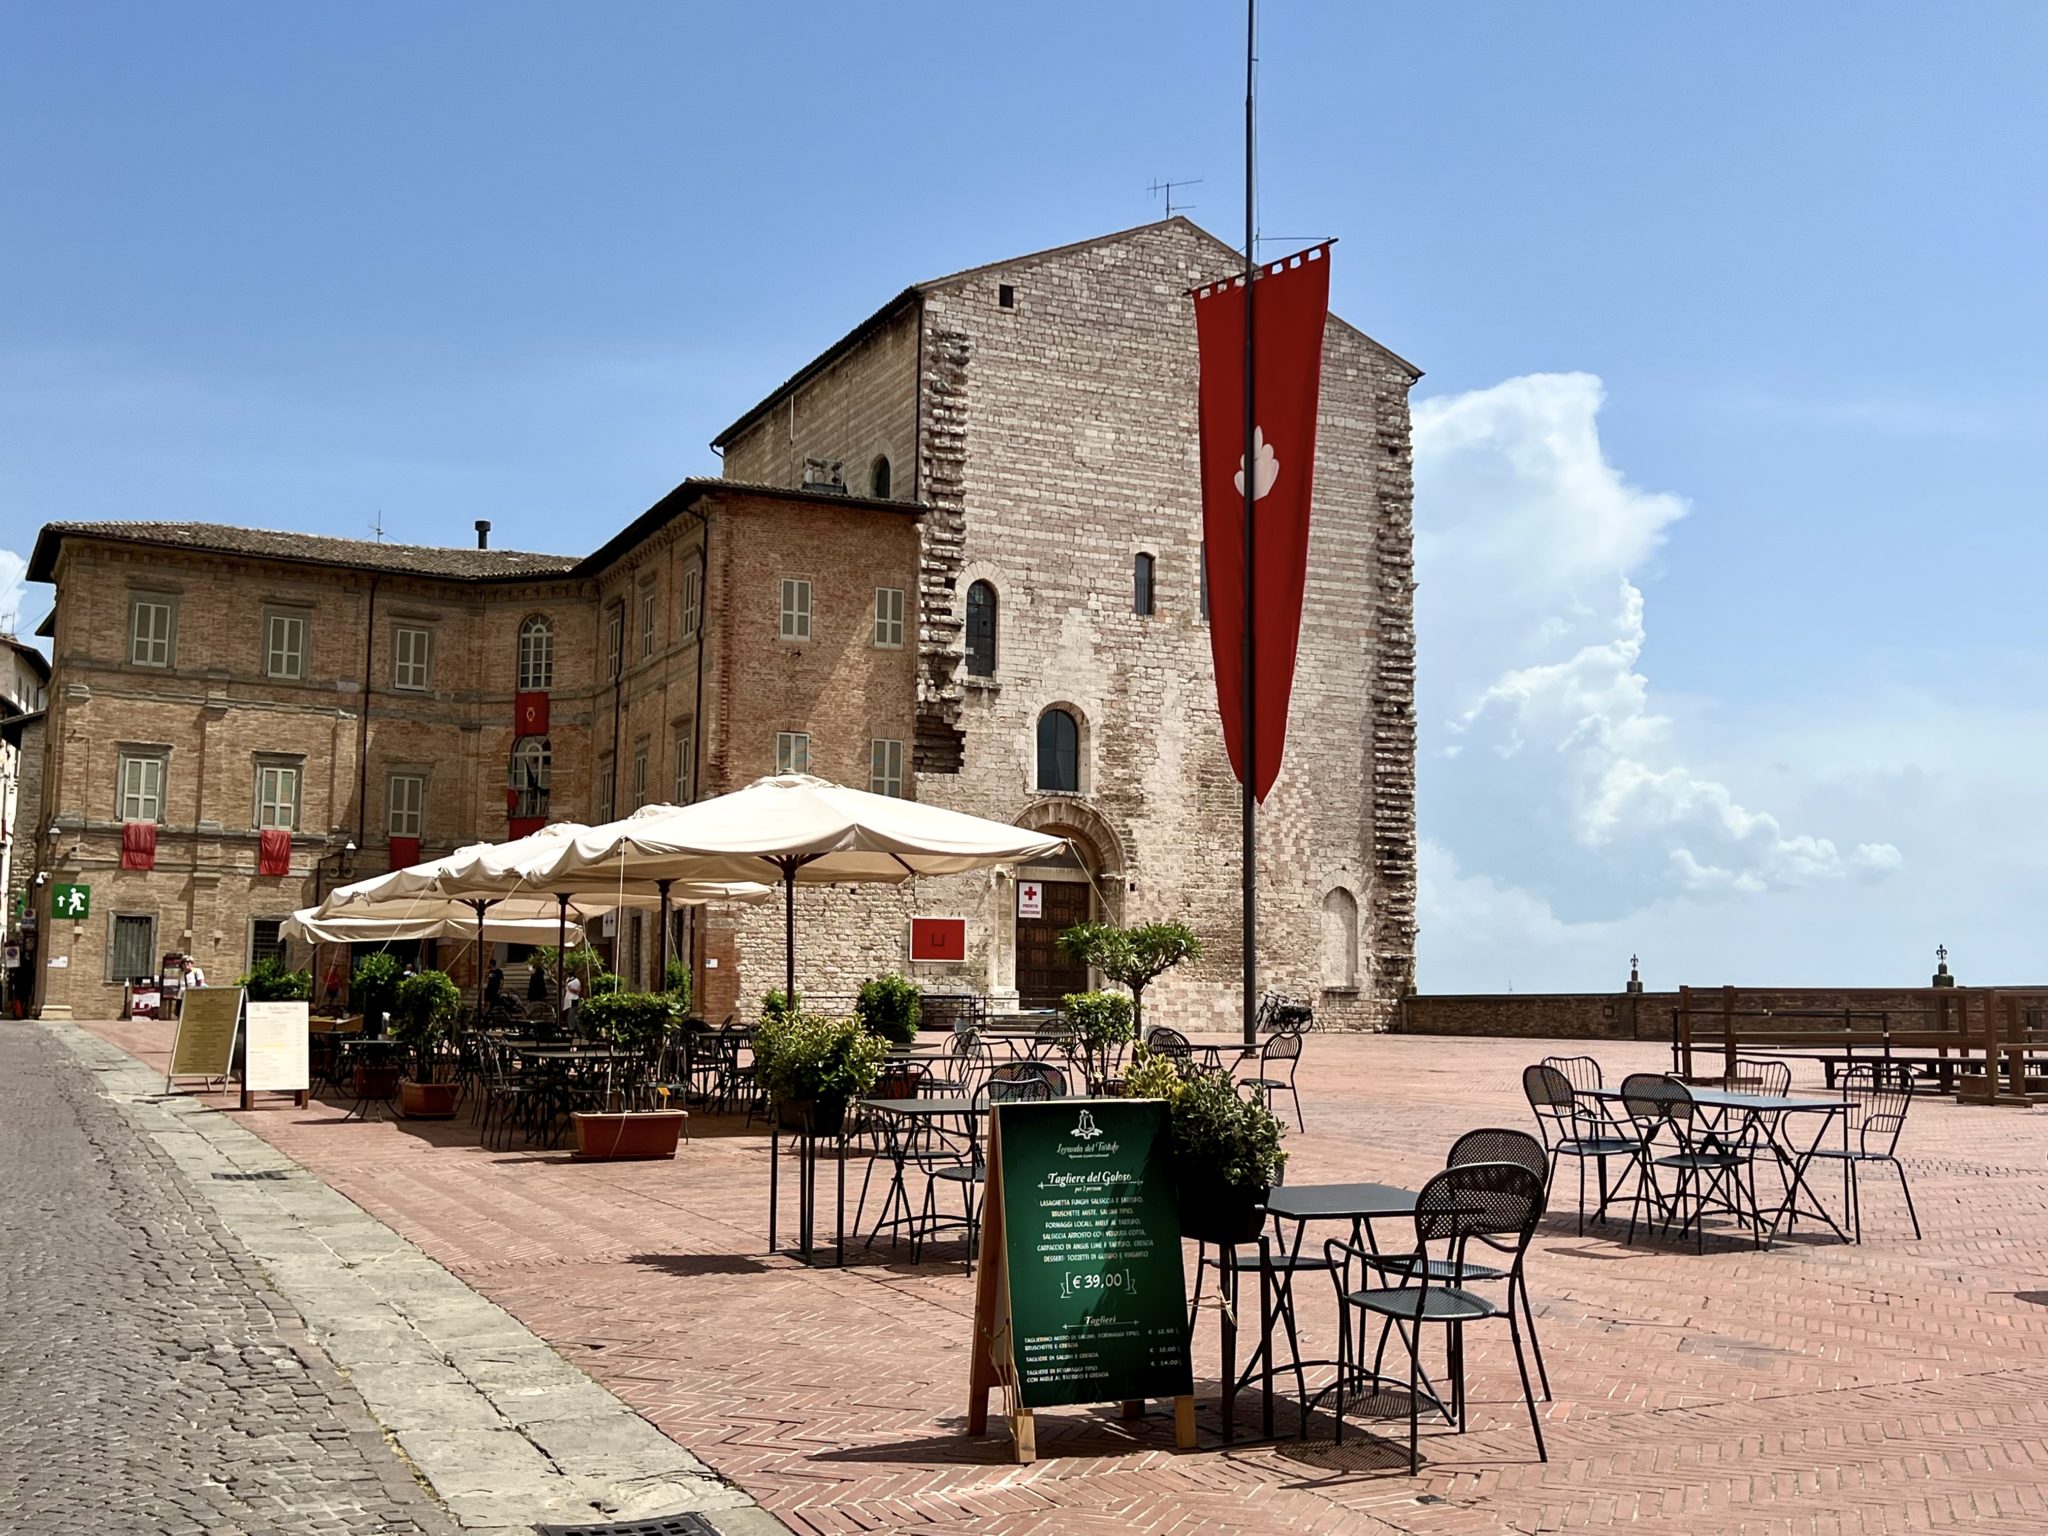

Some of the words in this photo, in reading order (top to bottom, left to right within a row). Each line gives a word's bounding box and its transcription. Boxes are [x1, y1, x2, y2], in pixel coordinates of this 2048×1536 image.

[1084, 1143, 1095, 1152] del
[1047, 1172, 1086, 1188] Tagliere
[1087, 1171, 1101, 1183] del
[1102, 1171, 1132, 1186] Goloso
[1051, 1210, 1080, 1218] BRUSCHETTE
[1045, 1221, 1073, 1229] FORMAGGI
[1042, 1232, 1067, 1240] SALSICCIA
[1067, 1231, 1091, 1239] ARROSTO
[1037, 1243, 1064, 1252] CARPACCIO
[1072, 1242, 1089, 1250] ANGUS
[1067, 1253, 1089, 1261] TOZZETTI
[1072, 1275, 1082, 1289] €
[1084, 1273, 1122, 1289] 39,00
[1084, 1315, 1117, 1327] Taglieri
